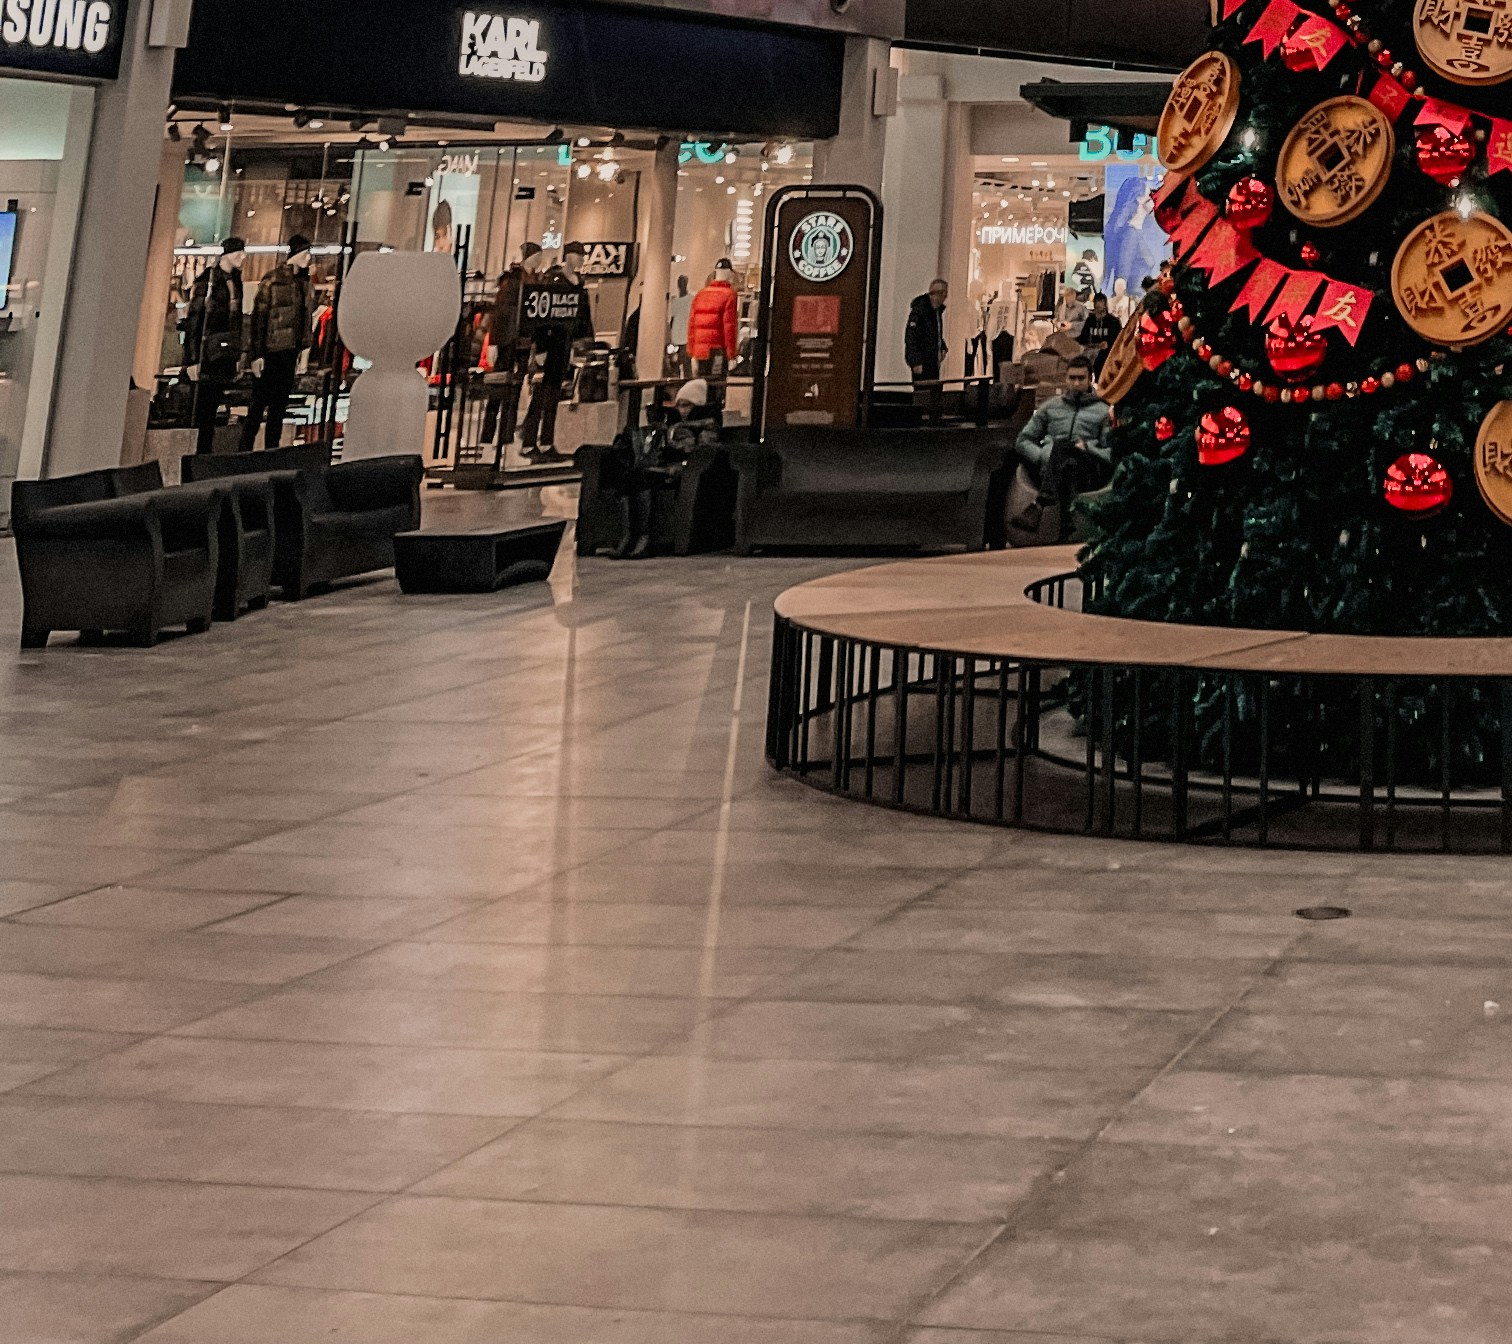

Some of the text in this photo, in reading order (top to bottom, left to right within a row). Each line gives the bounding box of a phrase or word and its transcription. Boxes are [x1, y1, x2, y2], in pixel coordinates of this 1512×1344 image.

[461, 11, 548, 64] KARL
[1079, 125, 1158, 161] Be
[800, 215, 844, 234] STARS
[797, 258, 842, 279] COFFEE
[1321, 290, 1357, 328] 友
